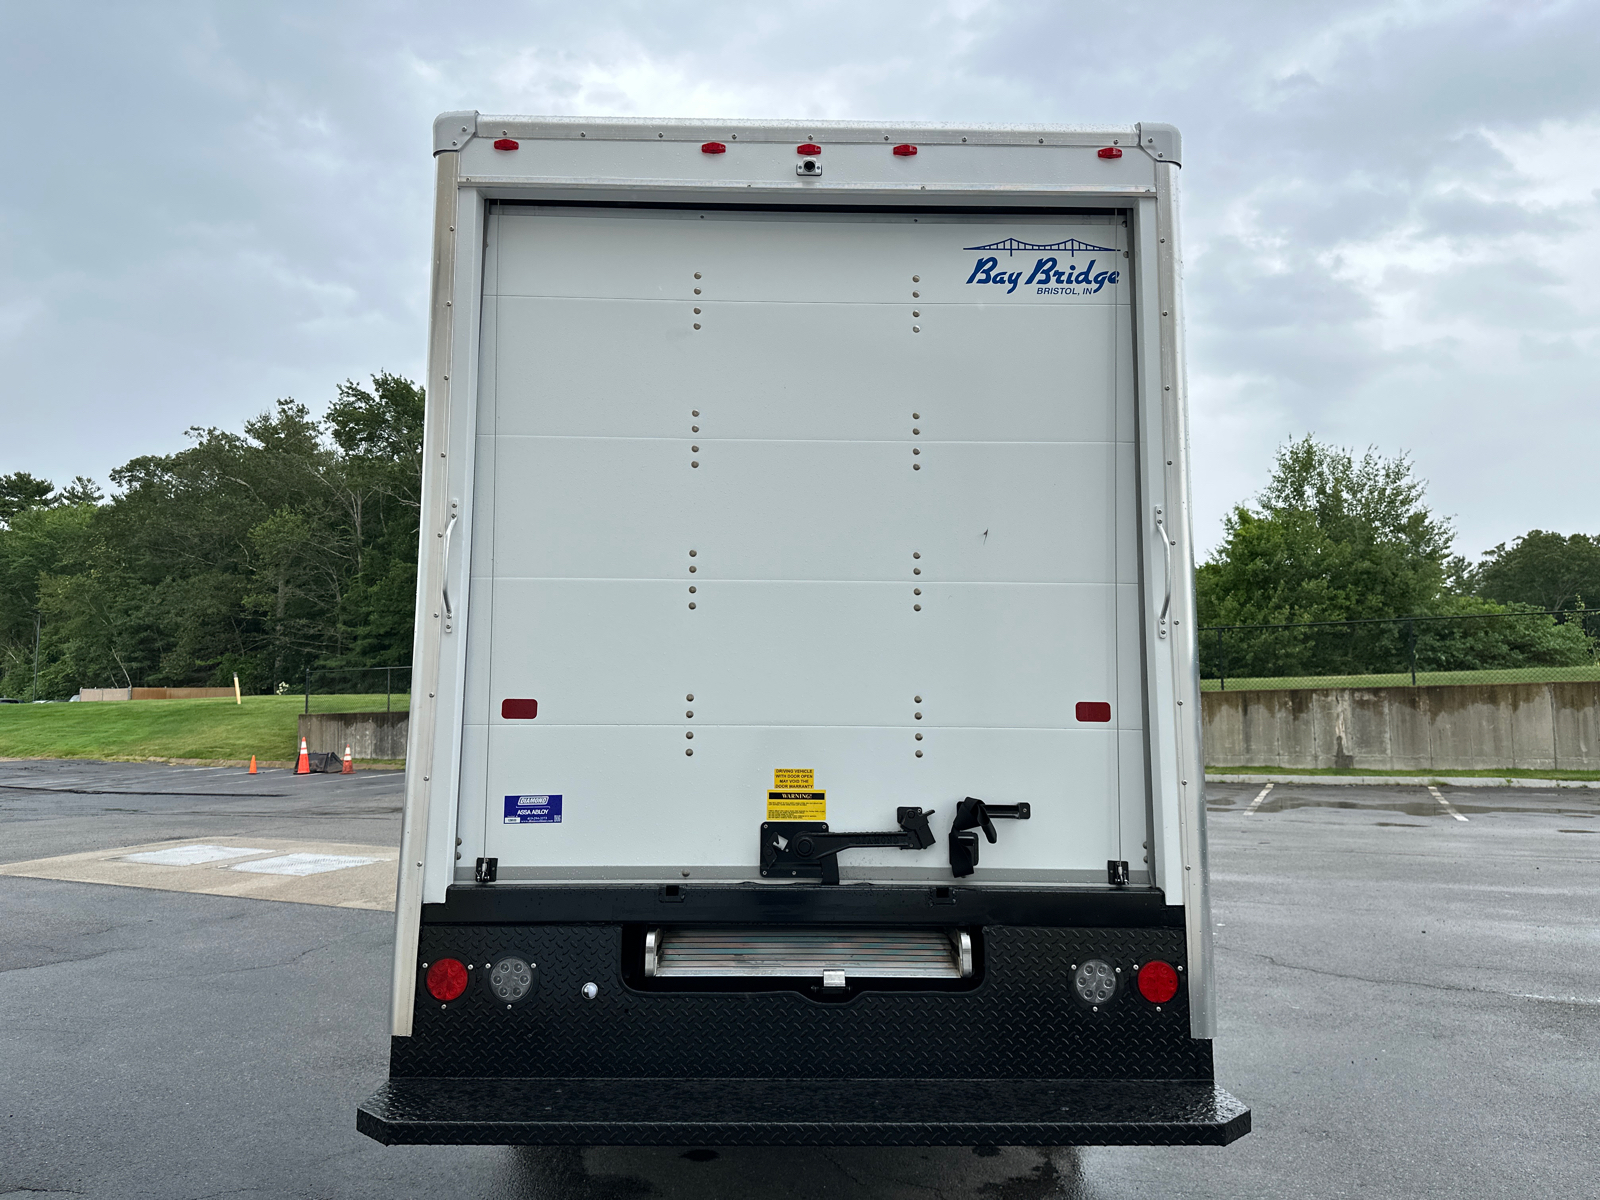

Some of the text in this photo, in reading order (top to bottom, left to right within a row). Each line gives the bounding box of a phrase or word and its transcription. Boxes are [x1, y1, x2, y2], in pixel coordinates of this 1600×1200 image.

[966, 257, 1120, 294] Bay Bridge
[1036, 287, 1093, 296] BRISTOL, IN
